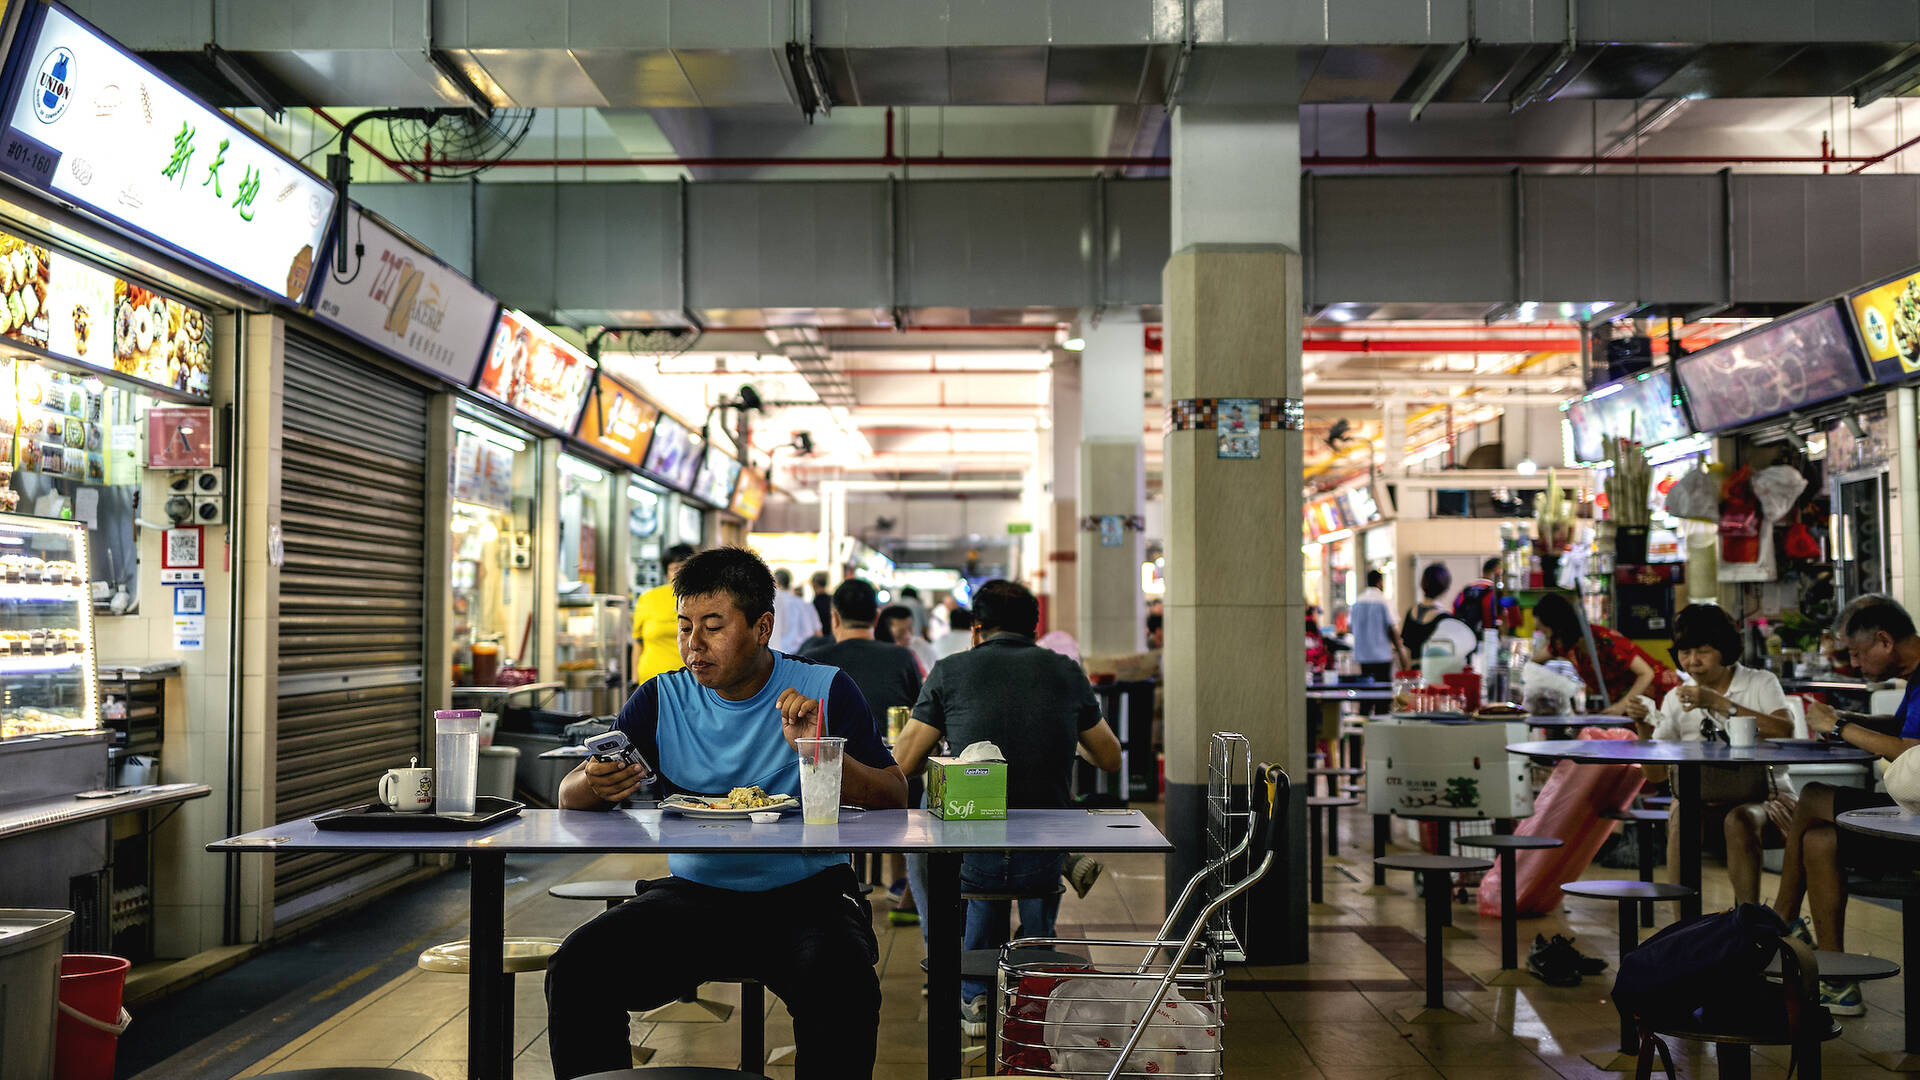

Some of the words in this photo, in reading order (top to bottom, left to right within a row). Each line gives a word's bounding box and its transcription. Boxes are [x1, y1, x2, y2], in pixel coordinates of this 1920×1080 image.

[40, 72, 72, 100] UNION
[7, 141, 52, 175] #01-160
[161, 119, 260, 222] 新天地
[946, 800, 975, 819] Soft
